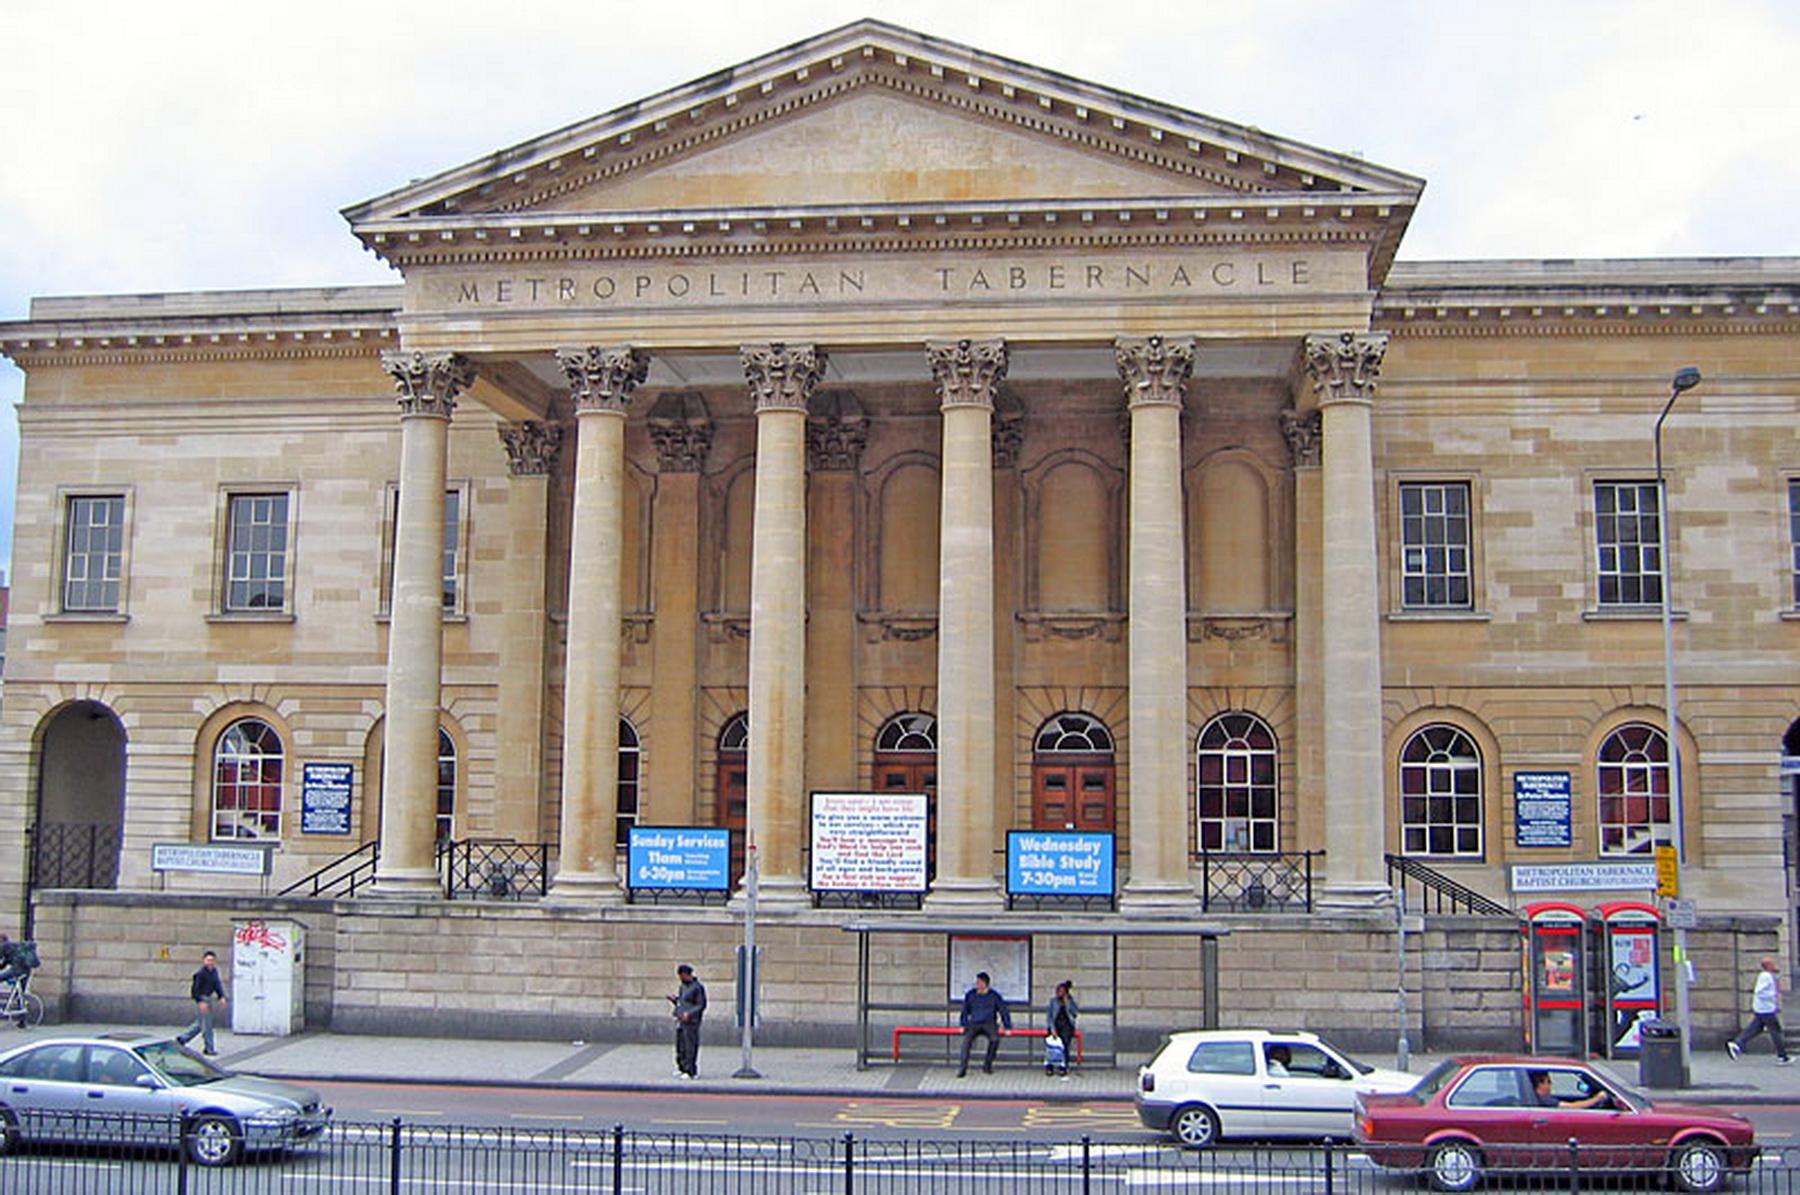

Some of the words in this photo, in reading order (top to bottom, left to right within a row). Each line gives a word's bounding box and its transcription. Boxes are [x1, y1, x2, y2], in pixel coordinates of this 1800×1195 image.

[457, 269, 865, 304] METROPOLITAN
[936, 260, 1311, 291] TABERNACLE
[633, 834, 675, 850] Sunday
[677, 834, 725, 847] Services
[1019, 837, 1101, 855] Wednesday
[649, 850, 682, 864] 11am
[1019, 855, 1055, 868] Bible
[1060, 855, 1101, 871] Study
